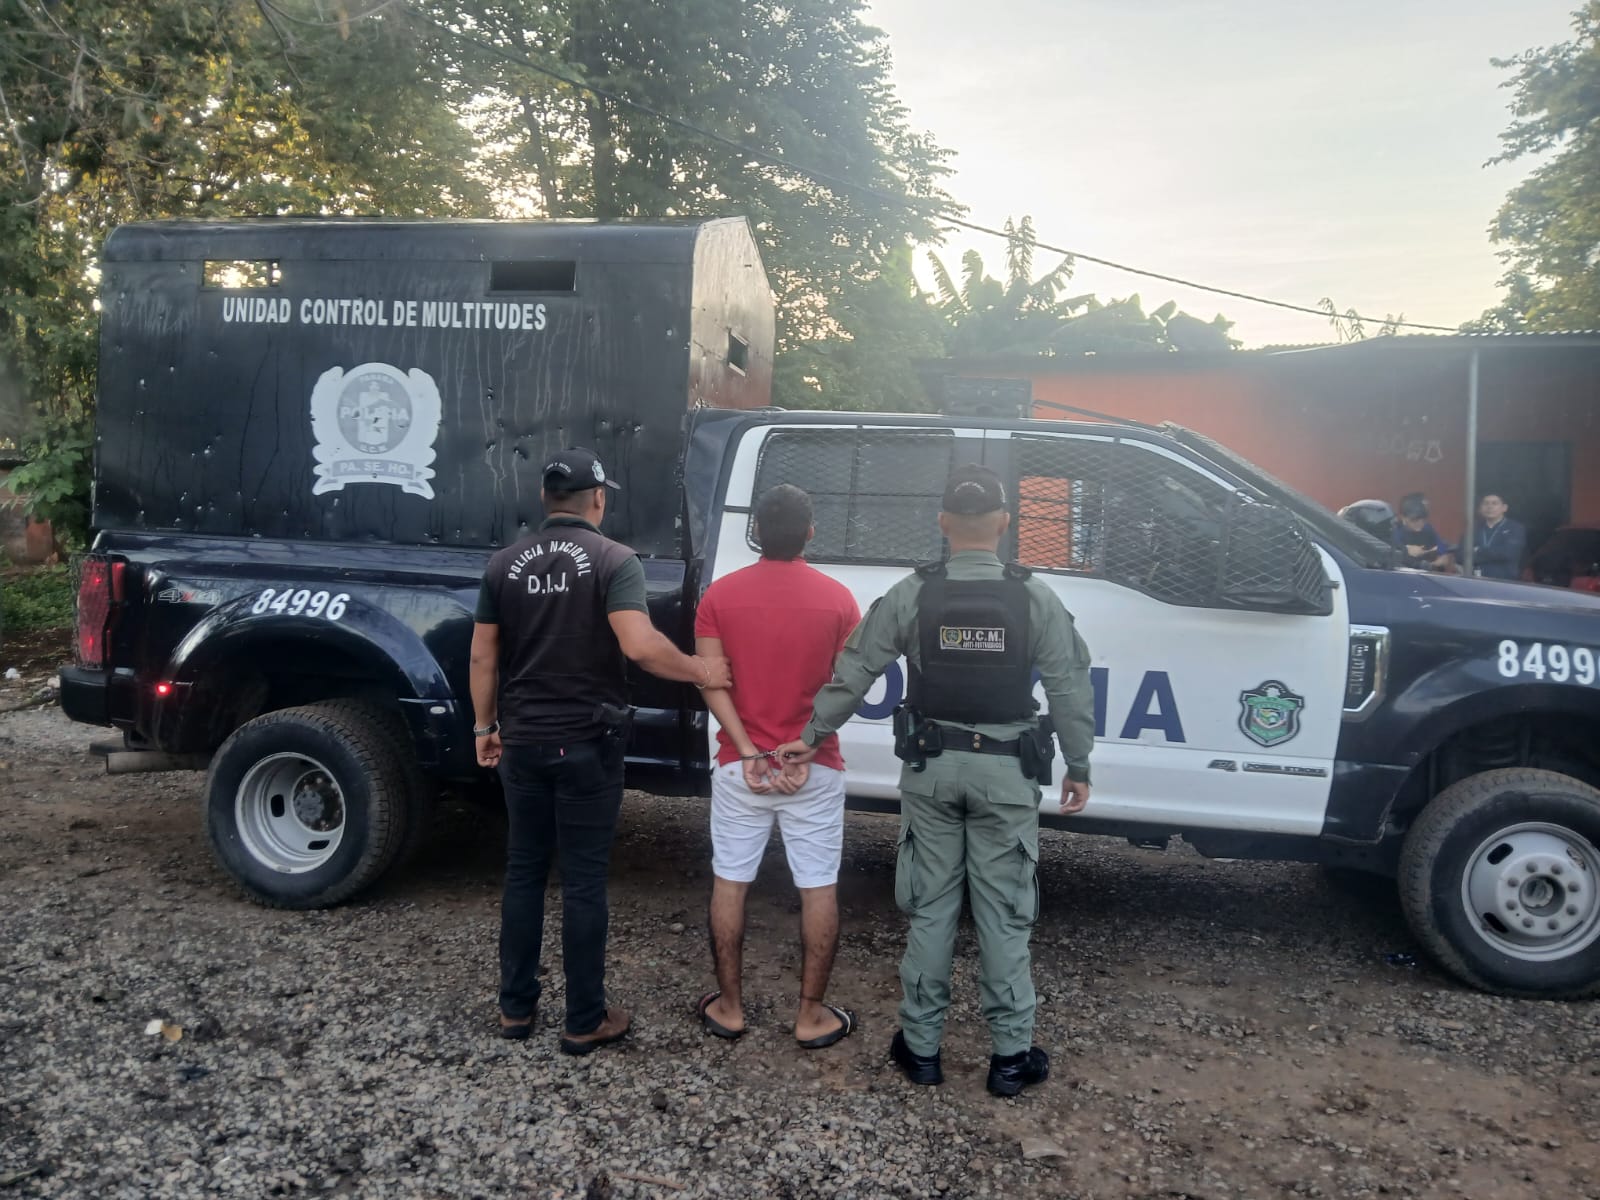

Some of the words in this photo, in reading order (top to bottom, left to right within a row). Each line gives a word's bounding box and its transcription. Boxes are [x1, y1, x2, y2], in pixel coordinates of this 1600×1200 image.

[223, 297, 292, 323] UNIDAD
[300, 298, 388, 326] CONTROL
[392, 300, 417, 327] DE
[422, 301, 547, 330] MULTITUDES
[508, 543, 544, 580] POLICIA
[549, 540, 591, 577] NACIONAL
[527, 572, 569, 594] D.I.J.
[252, 588, 350, 620] 84996
[962, 630, 1002, 642] U.C.M.
[1498, 639, 1600, 690] 8499
